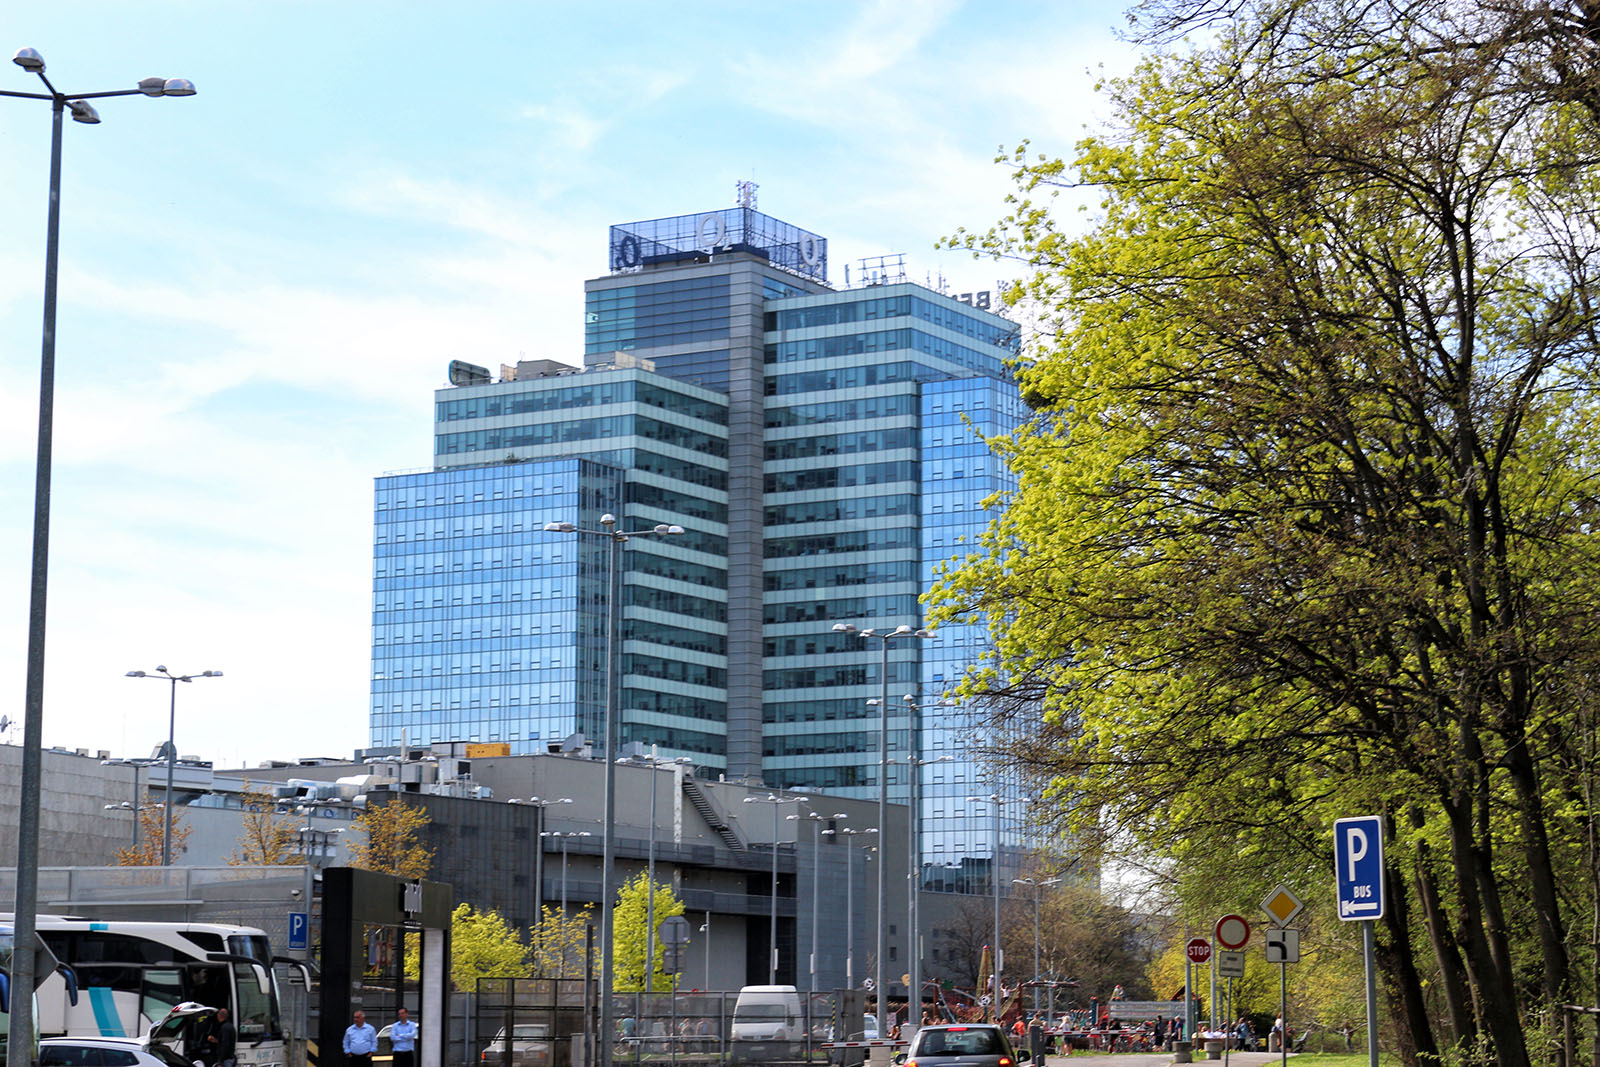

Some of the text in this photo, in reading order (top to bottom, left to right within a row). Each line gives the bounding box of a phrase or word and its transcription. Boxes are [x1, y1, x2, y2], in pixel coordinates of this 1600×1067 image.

[1347, 828, 1368, 882] P
[1353, 885, 1372, 899] BUS
[293, 915, 303, 936] P
[1188, 945, 1210, 956] STOP
